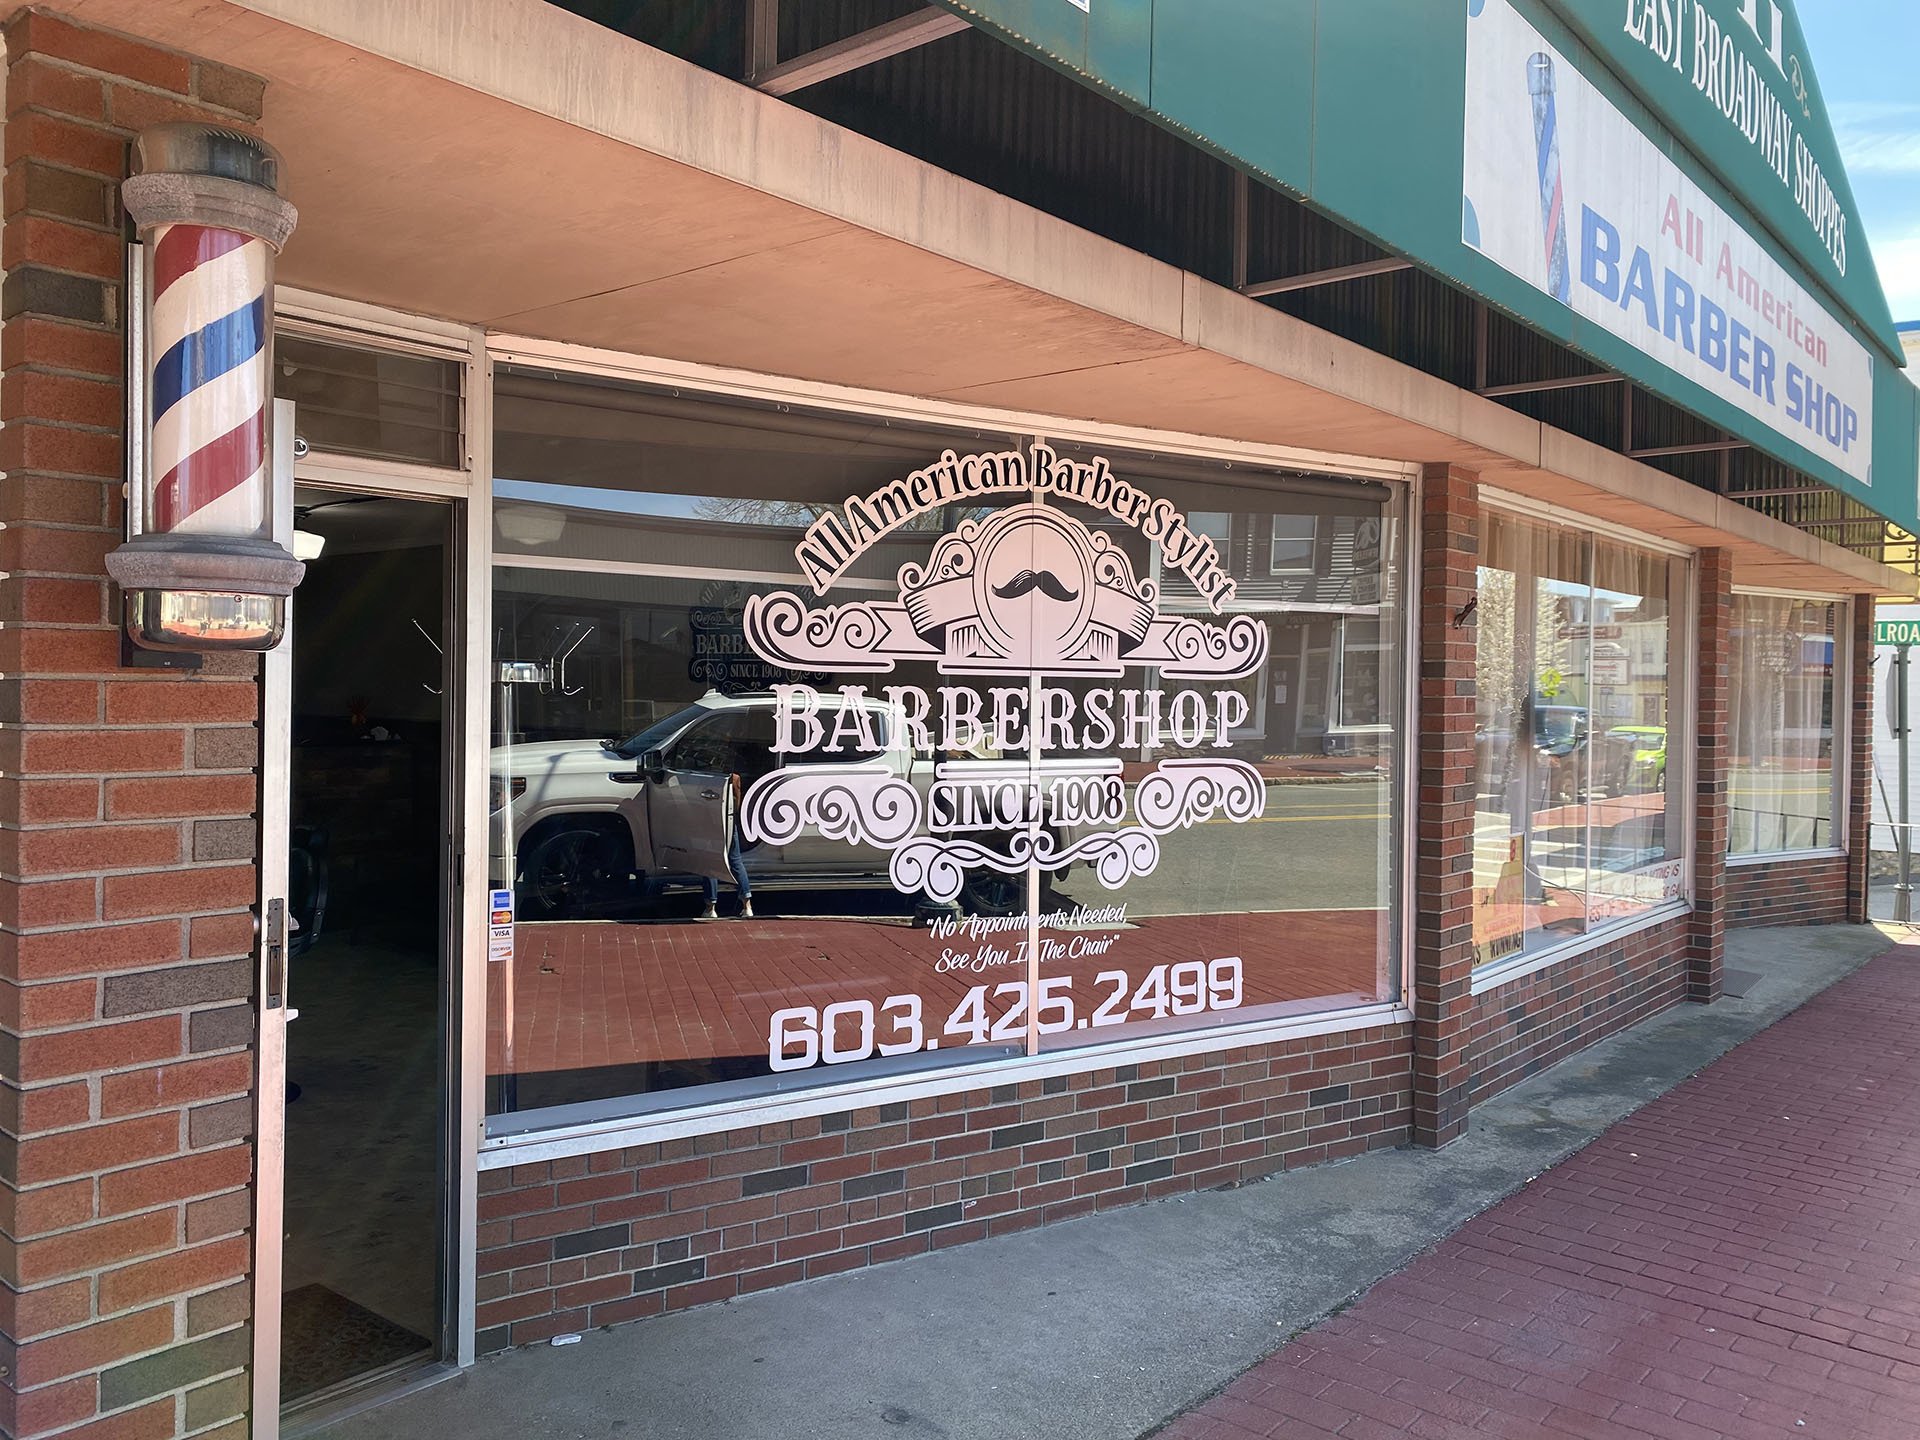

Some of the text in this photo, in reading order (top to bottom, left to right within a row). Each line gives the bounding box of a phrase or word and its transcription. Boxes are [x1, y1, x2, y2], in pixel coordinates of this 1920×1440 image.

[1692, 4, 1793, 188] BROADWAY
[1795, 133, 1847, 277] SHOPPES
[1661, 193, 1828, 368] All American
[1581, 203, 1857, 454] BARBER SHOP
[800, 448, 1232, 610] All American Barber Stylist
[730, 664, 758, 678] SINCE
[769, 684, 1250, 753] BARBERSHOP
[932, 780, 1121, 828] SINCE 1908
[926, 914, 957, 940] "No
[1068, 902, 1128, 927] Needed,
[934, 948, 969, 973] See
[971, 945, 1008, 972] You
[1040, 939, 1065, 963] The
[1068, 934, 1120, 959] Chair"
[769, 956, 1243, 1072] 603.425.2499
